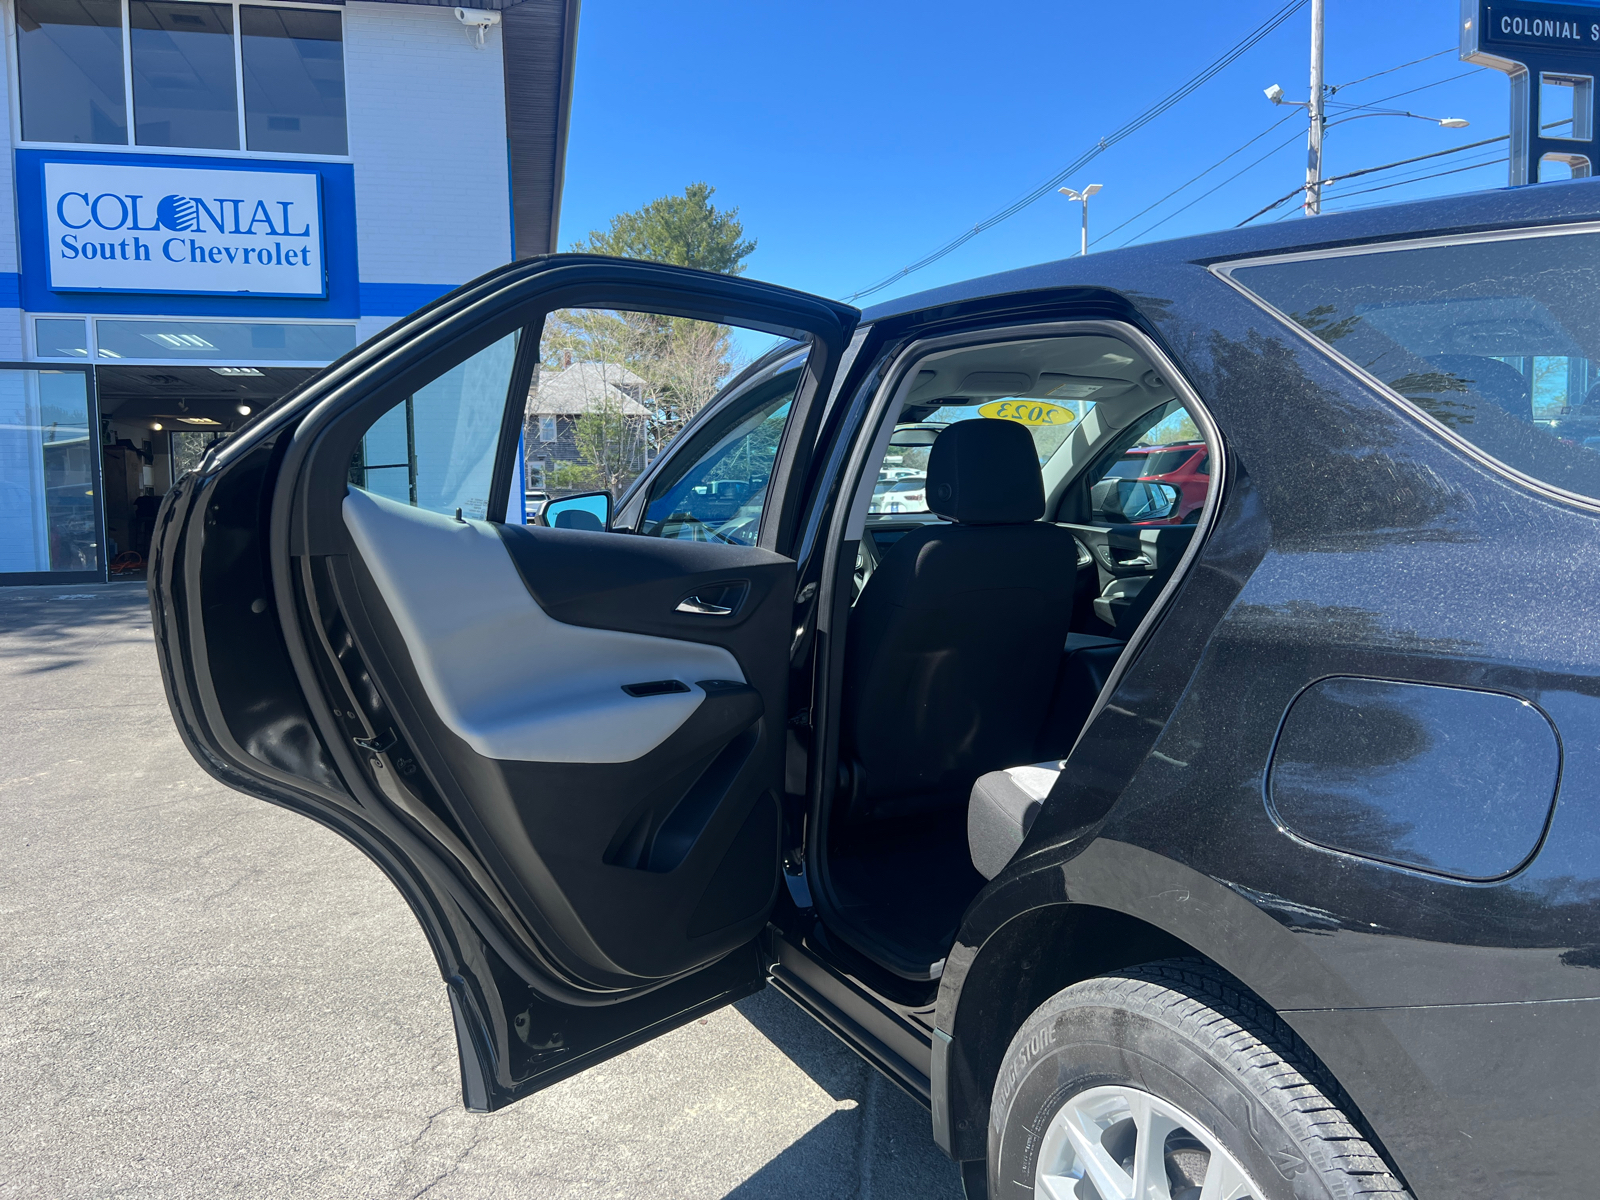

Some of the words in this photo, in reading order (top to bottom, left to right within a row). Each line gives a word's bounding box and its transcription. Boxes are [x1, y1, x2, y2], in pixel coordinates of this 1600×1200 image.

[1501, 16, 1580, 39] COLONIAL
[1591, 24, 1600, 41] S
[57, 192, 310, 237] COLONIAL
[61, 234, 152, 262] South
[162, 238, 312, 267] Chevrolet
[992, 1022, 1056, 1134] DGESTONE
